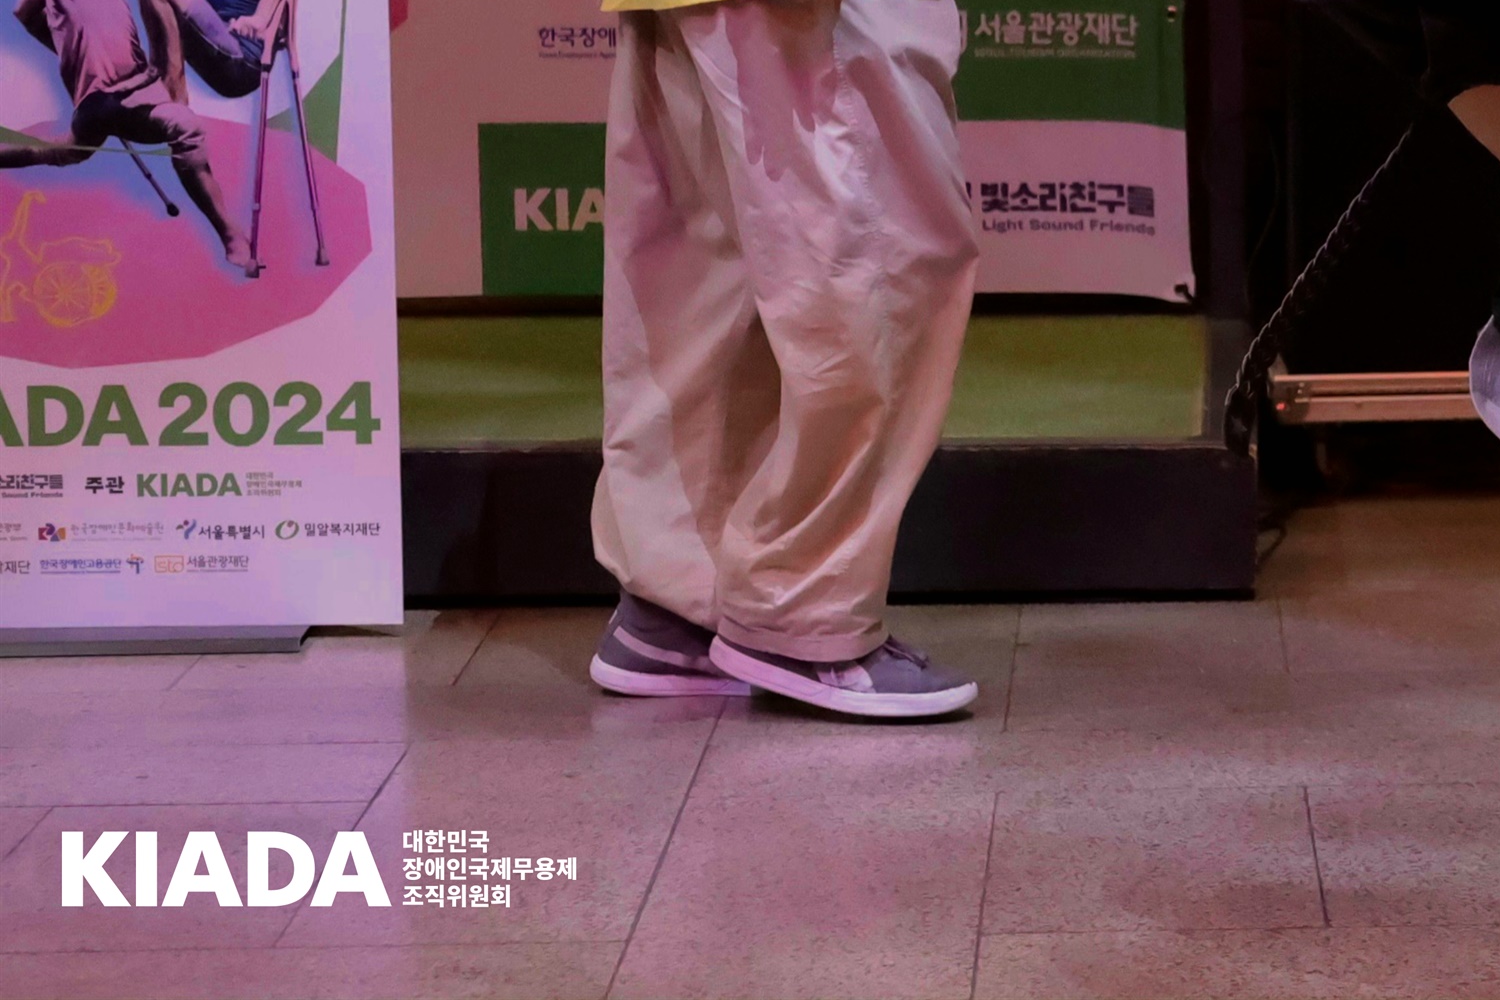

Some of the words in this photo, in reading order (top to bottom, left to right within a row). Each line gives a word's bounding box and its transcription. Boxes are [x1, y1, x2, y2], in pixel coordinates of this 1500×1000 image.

[974, 10, 1139, 46] 서울관광재단
[980, 181, 1155, 217] 빛소리친구들
[982, 219, 1024, 233] Light
[1030, 219, 1084, 232] Sound
[1089, 219, 1155, 236] Friends
[85, 476, 125, 494] 주관
[137, 472, 243, 498] KIADA
[198, 524, 265, 541] 서울특별시
[304, 521, 381, 537] 밀알복지재단
[187, 554, 249, 569] 서울관광재단
